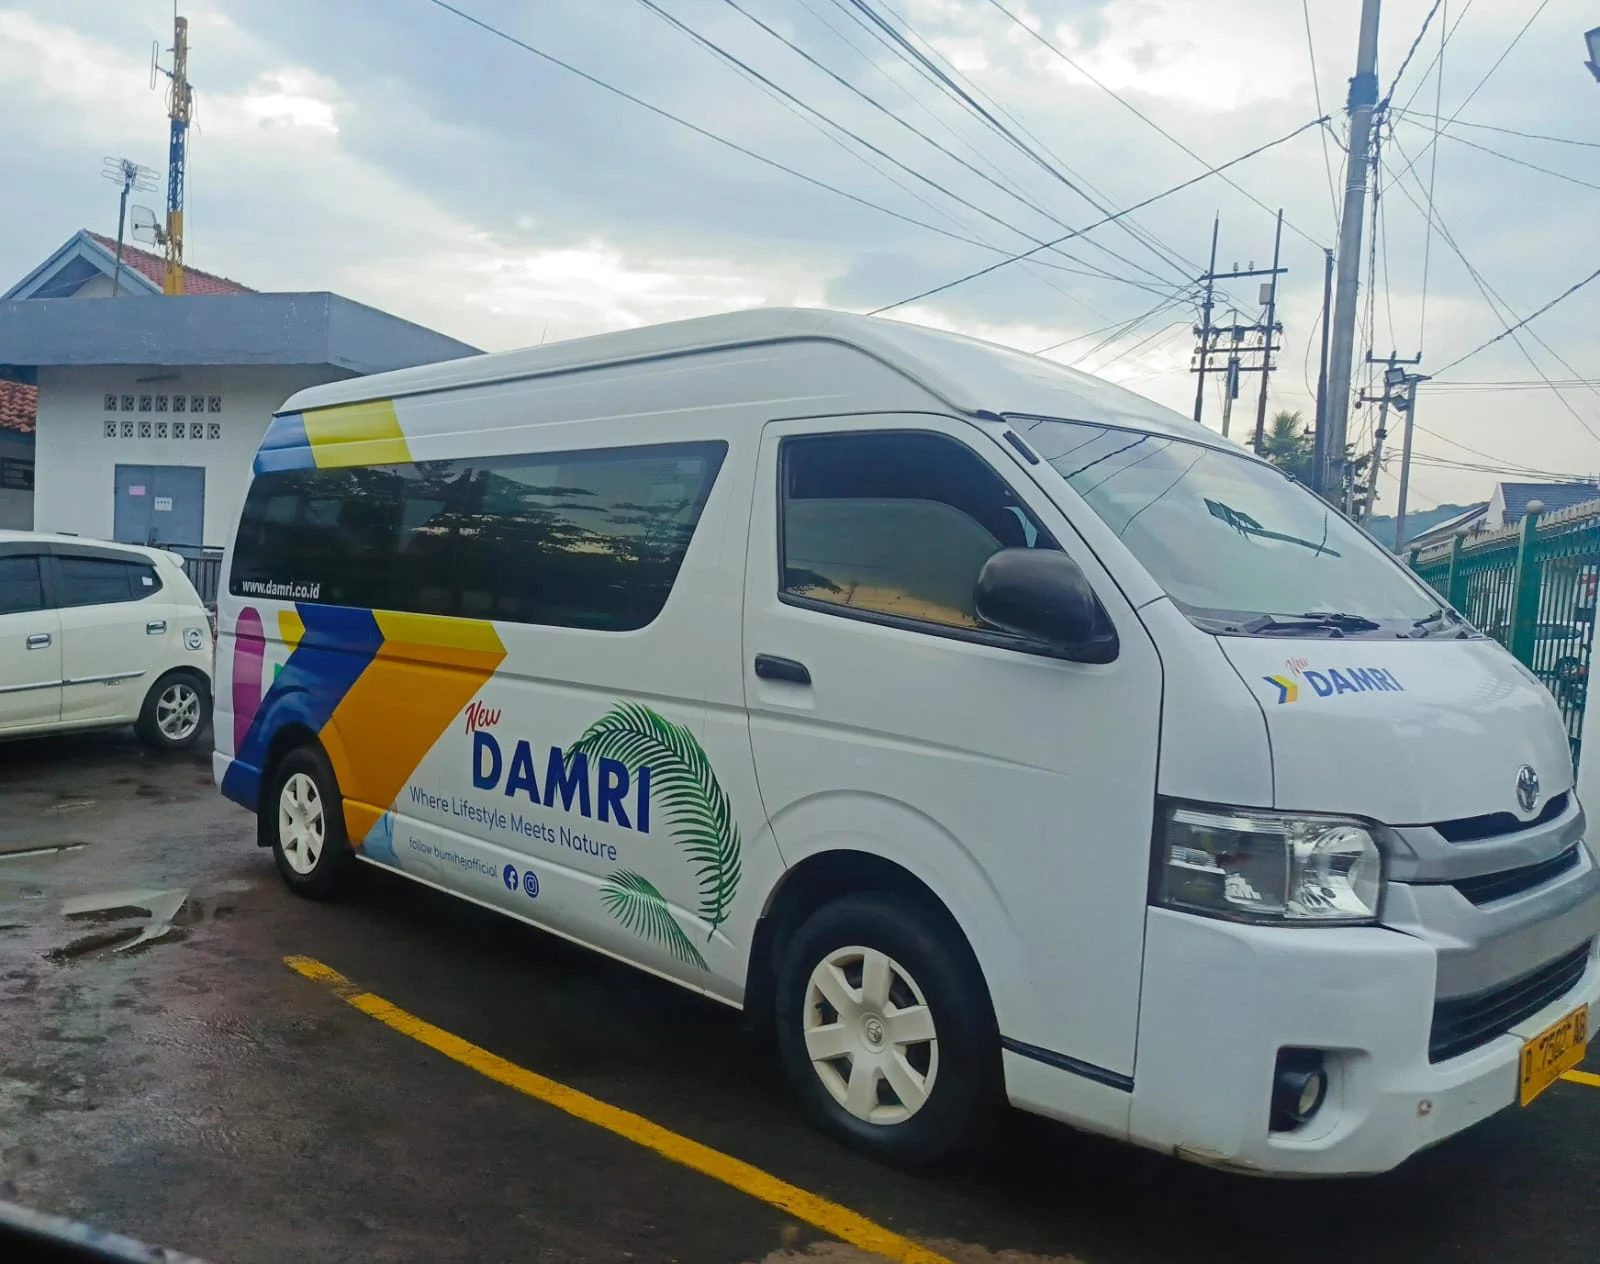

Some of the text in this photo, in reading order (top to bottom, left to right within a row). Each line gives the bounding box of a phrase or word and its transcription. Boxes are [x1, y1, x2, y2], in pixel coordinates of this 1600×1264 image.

[242, 579, 320, 599] www.damri.co.id
[1303, 668, 1404, 697] DAMRI
[465, 700, 501, 735] New
[473, 731, 650, 834] DAMRI
[410, 784, 617, 861] Where Lifestyle Meets Nature
[409, 836, 432, 854] follow
